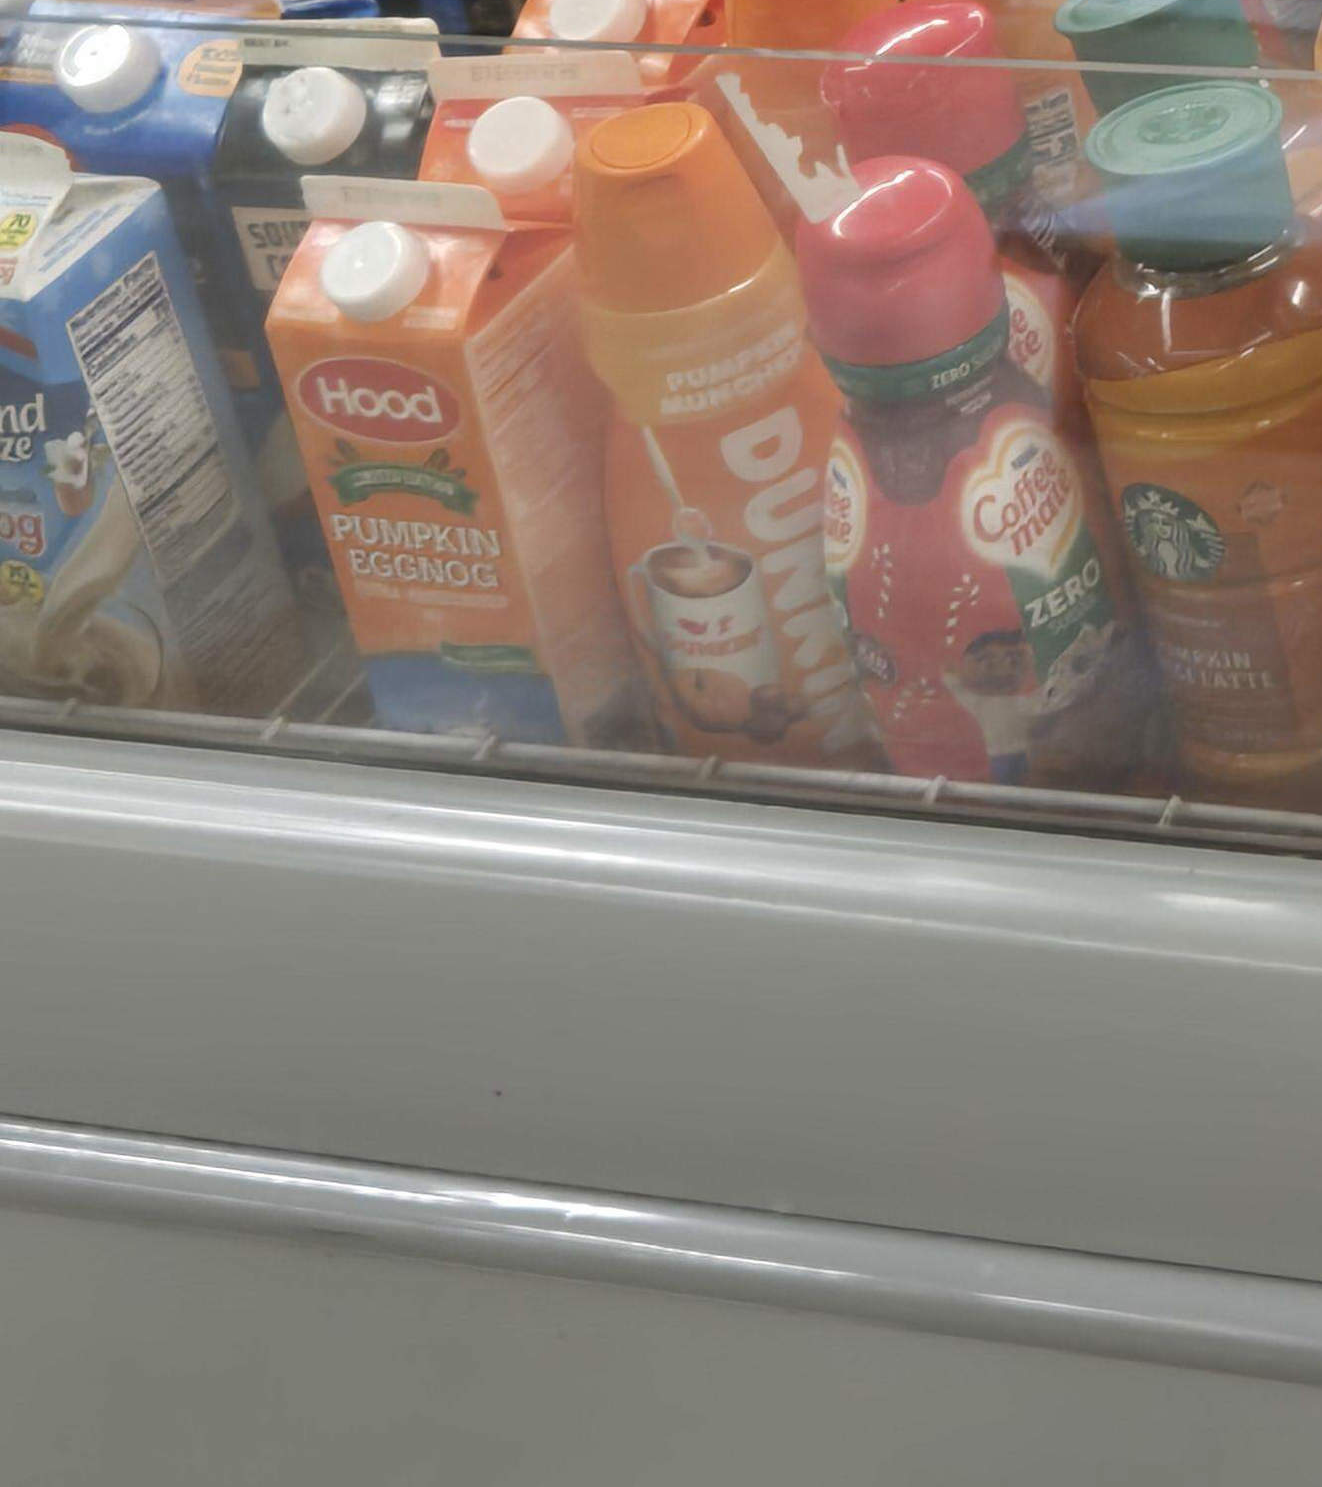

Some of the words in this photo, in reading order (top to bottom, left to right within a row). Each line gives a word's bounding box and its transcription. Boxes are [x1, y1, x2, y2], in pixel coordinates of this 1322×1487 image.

[315, 375, 444, 425] Hood
[972, 449, 1058, 544] Coffee
[1009, 466, 1073, 558] mate
[331, 512, 501, 559] PUMPKIN
[348, 548, 500, 589] EGGNOG
[1023, 557, 1102, 630] ZERO
